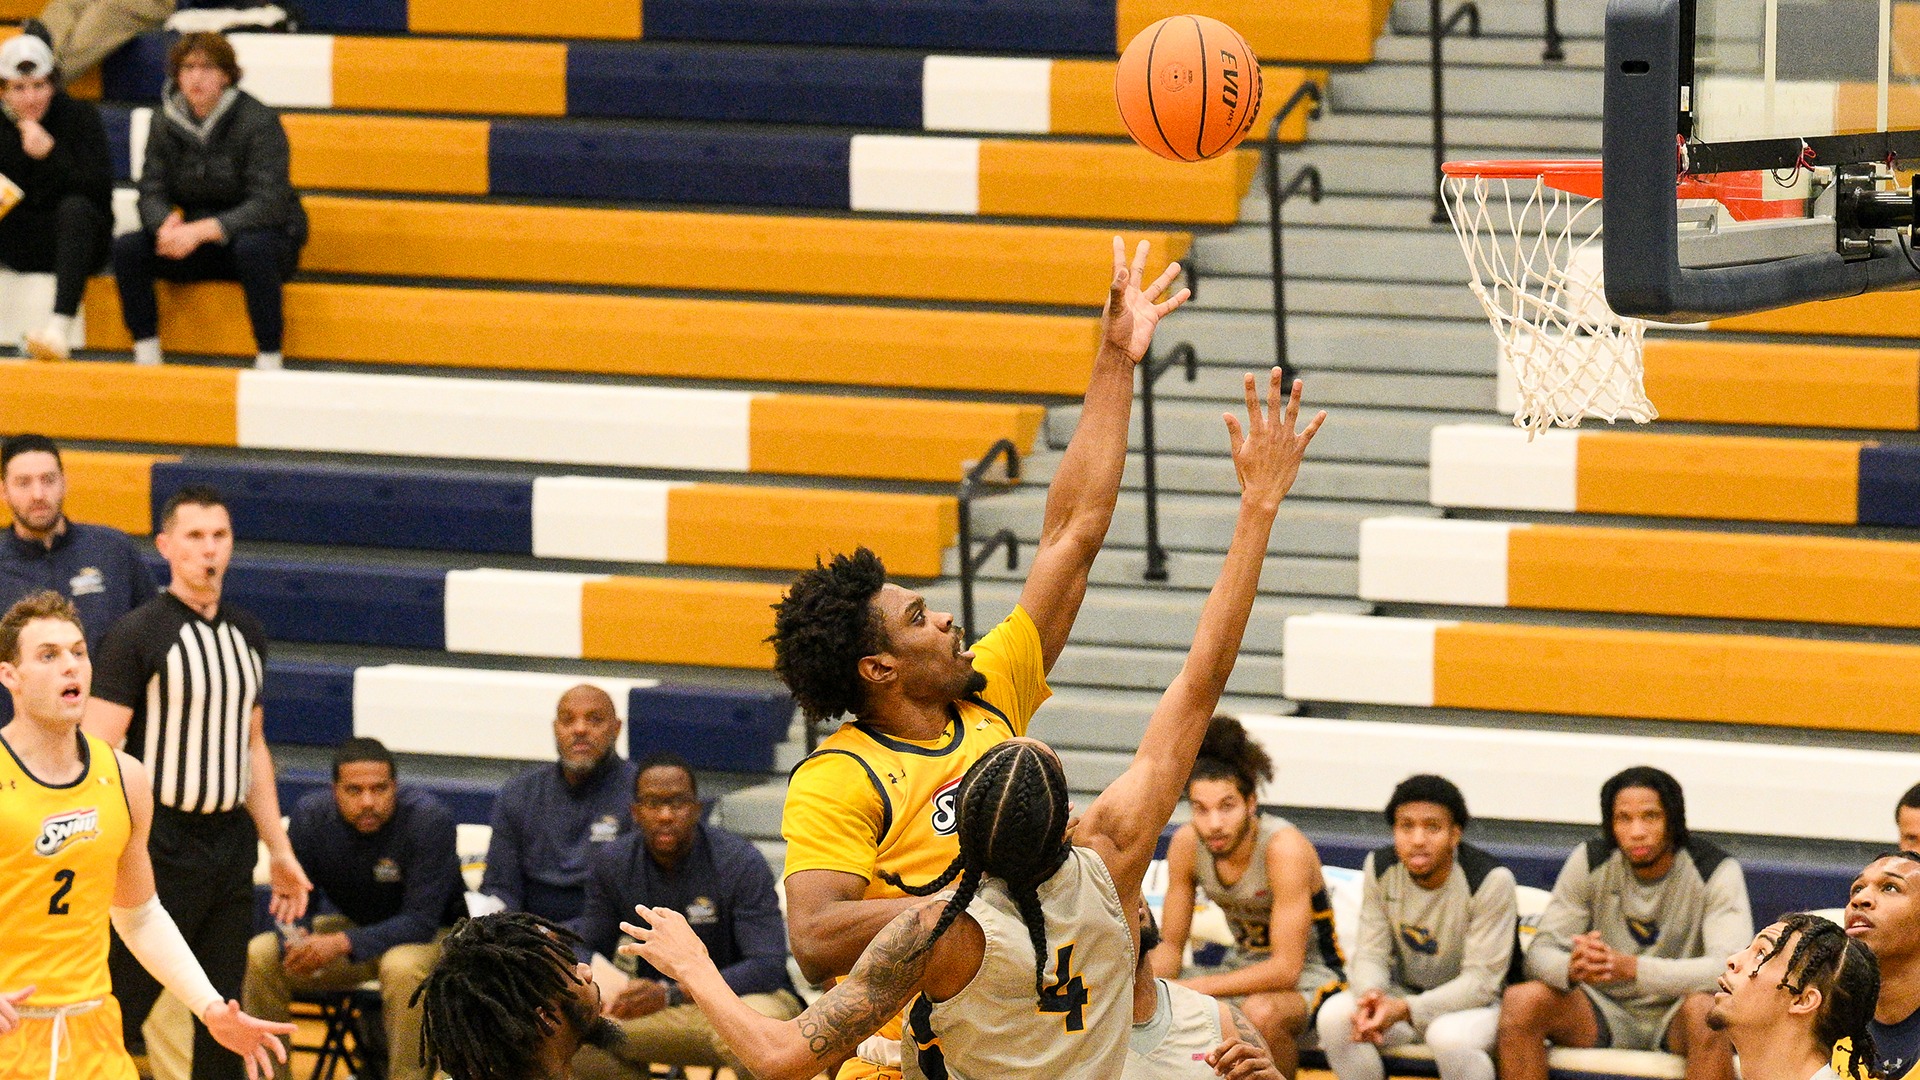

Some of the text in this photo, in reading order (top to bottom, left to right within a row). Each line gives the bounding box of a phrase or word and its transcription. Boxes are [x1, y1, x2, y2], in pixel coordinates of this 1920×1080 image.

[1221, 49, 1239, 109] EVO
[48, 869, 76, 915] 2
[1036, 941, 1091, 1034] 4
